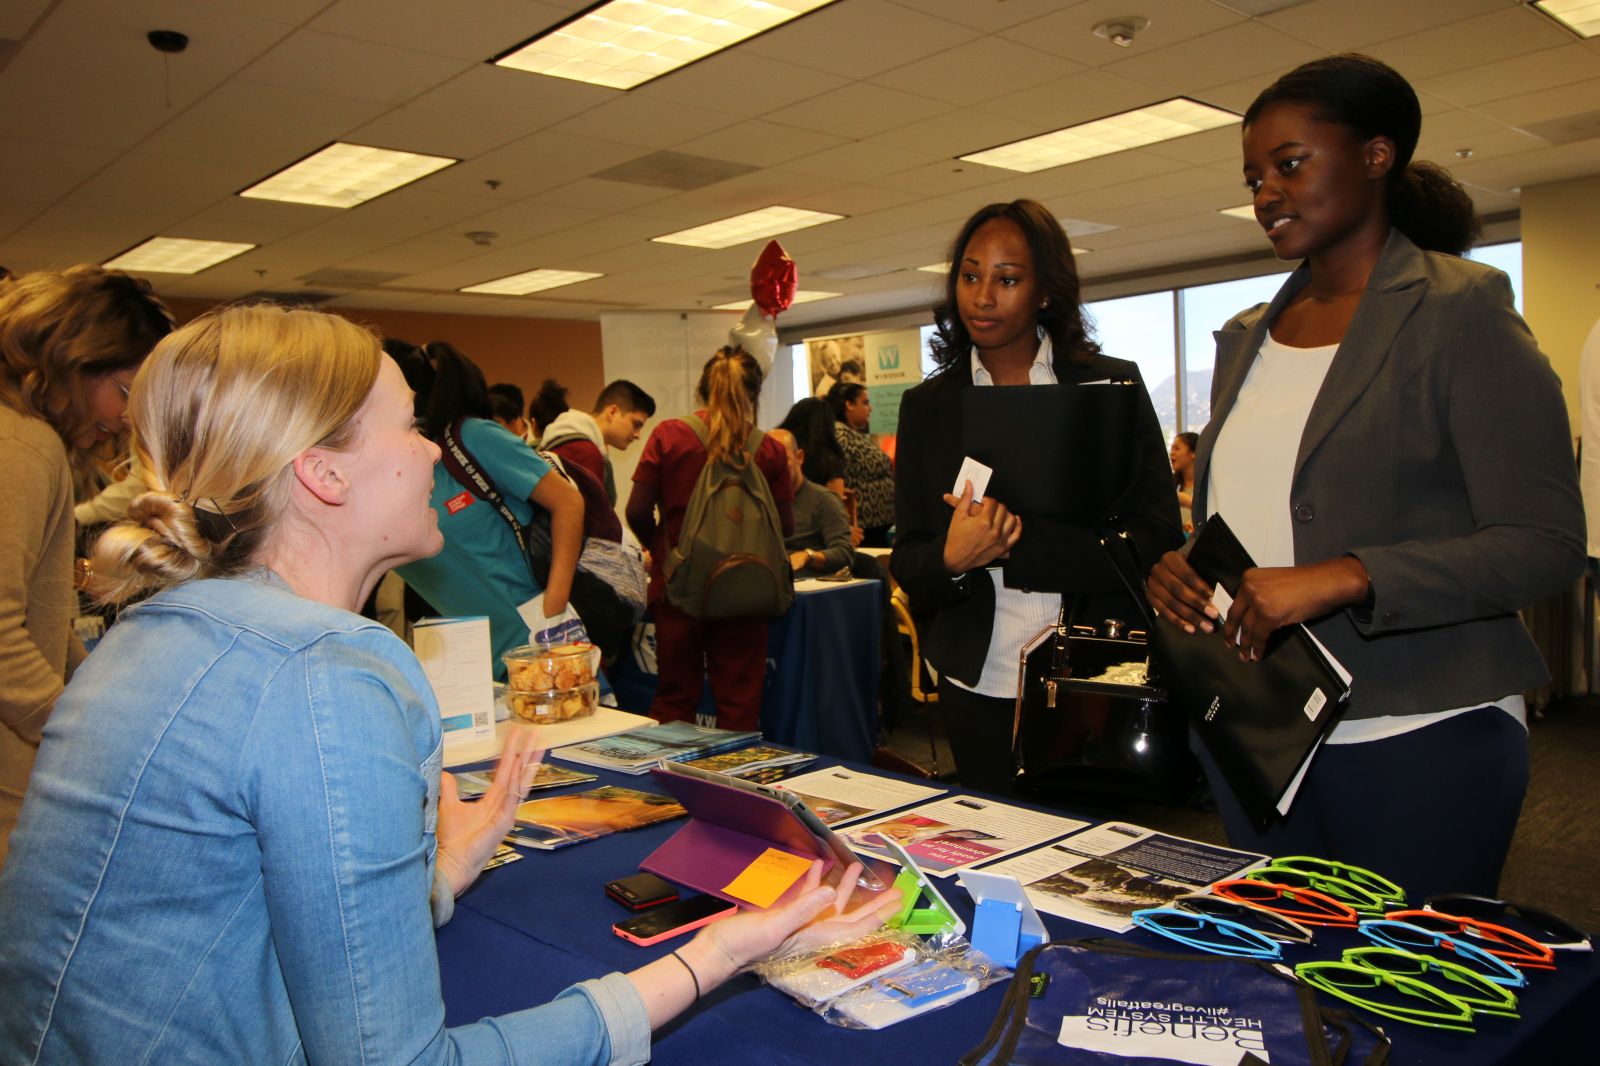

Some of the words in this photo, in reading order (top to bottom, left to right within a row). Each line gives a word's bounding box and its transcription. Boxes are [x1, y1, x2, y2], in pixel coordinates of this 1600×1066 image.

[1087, 1006, 1171, 1023] SYSTEM
[1097, 997, 1229, 1016] #livegreatfalls
[1180, 1014, 1263, 1029] HEALTH
[1086, 1017, 1265, 1050] Benefis
